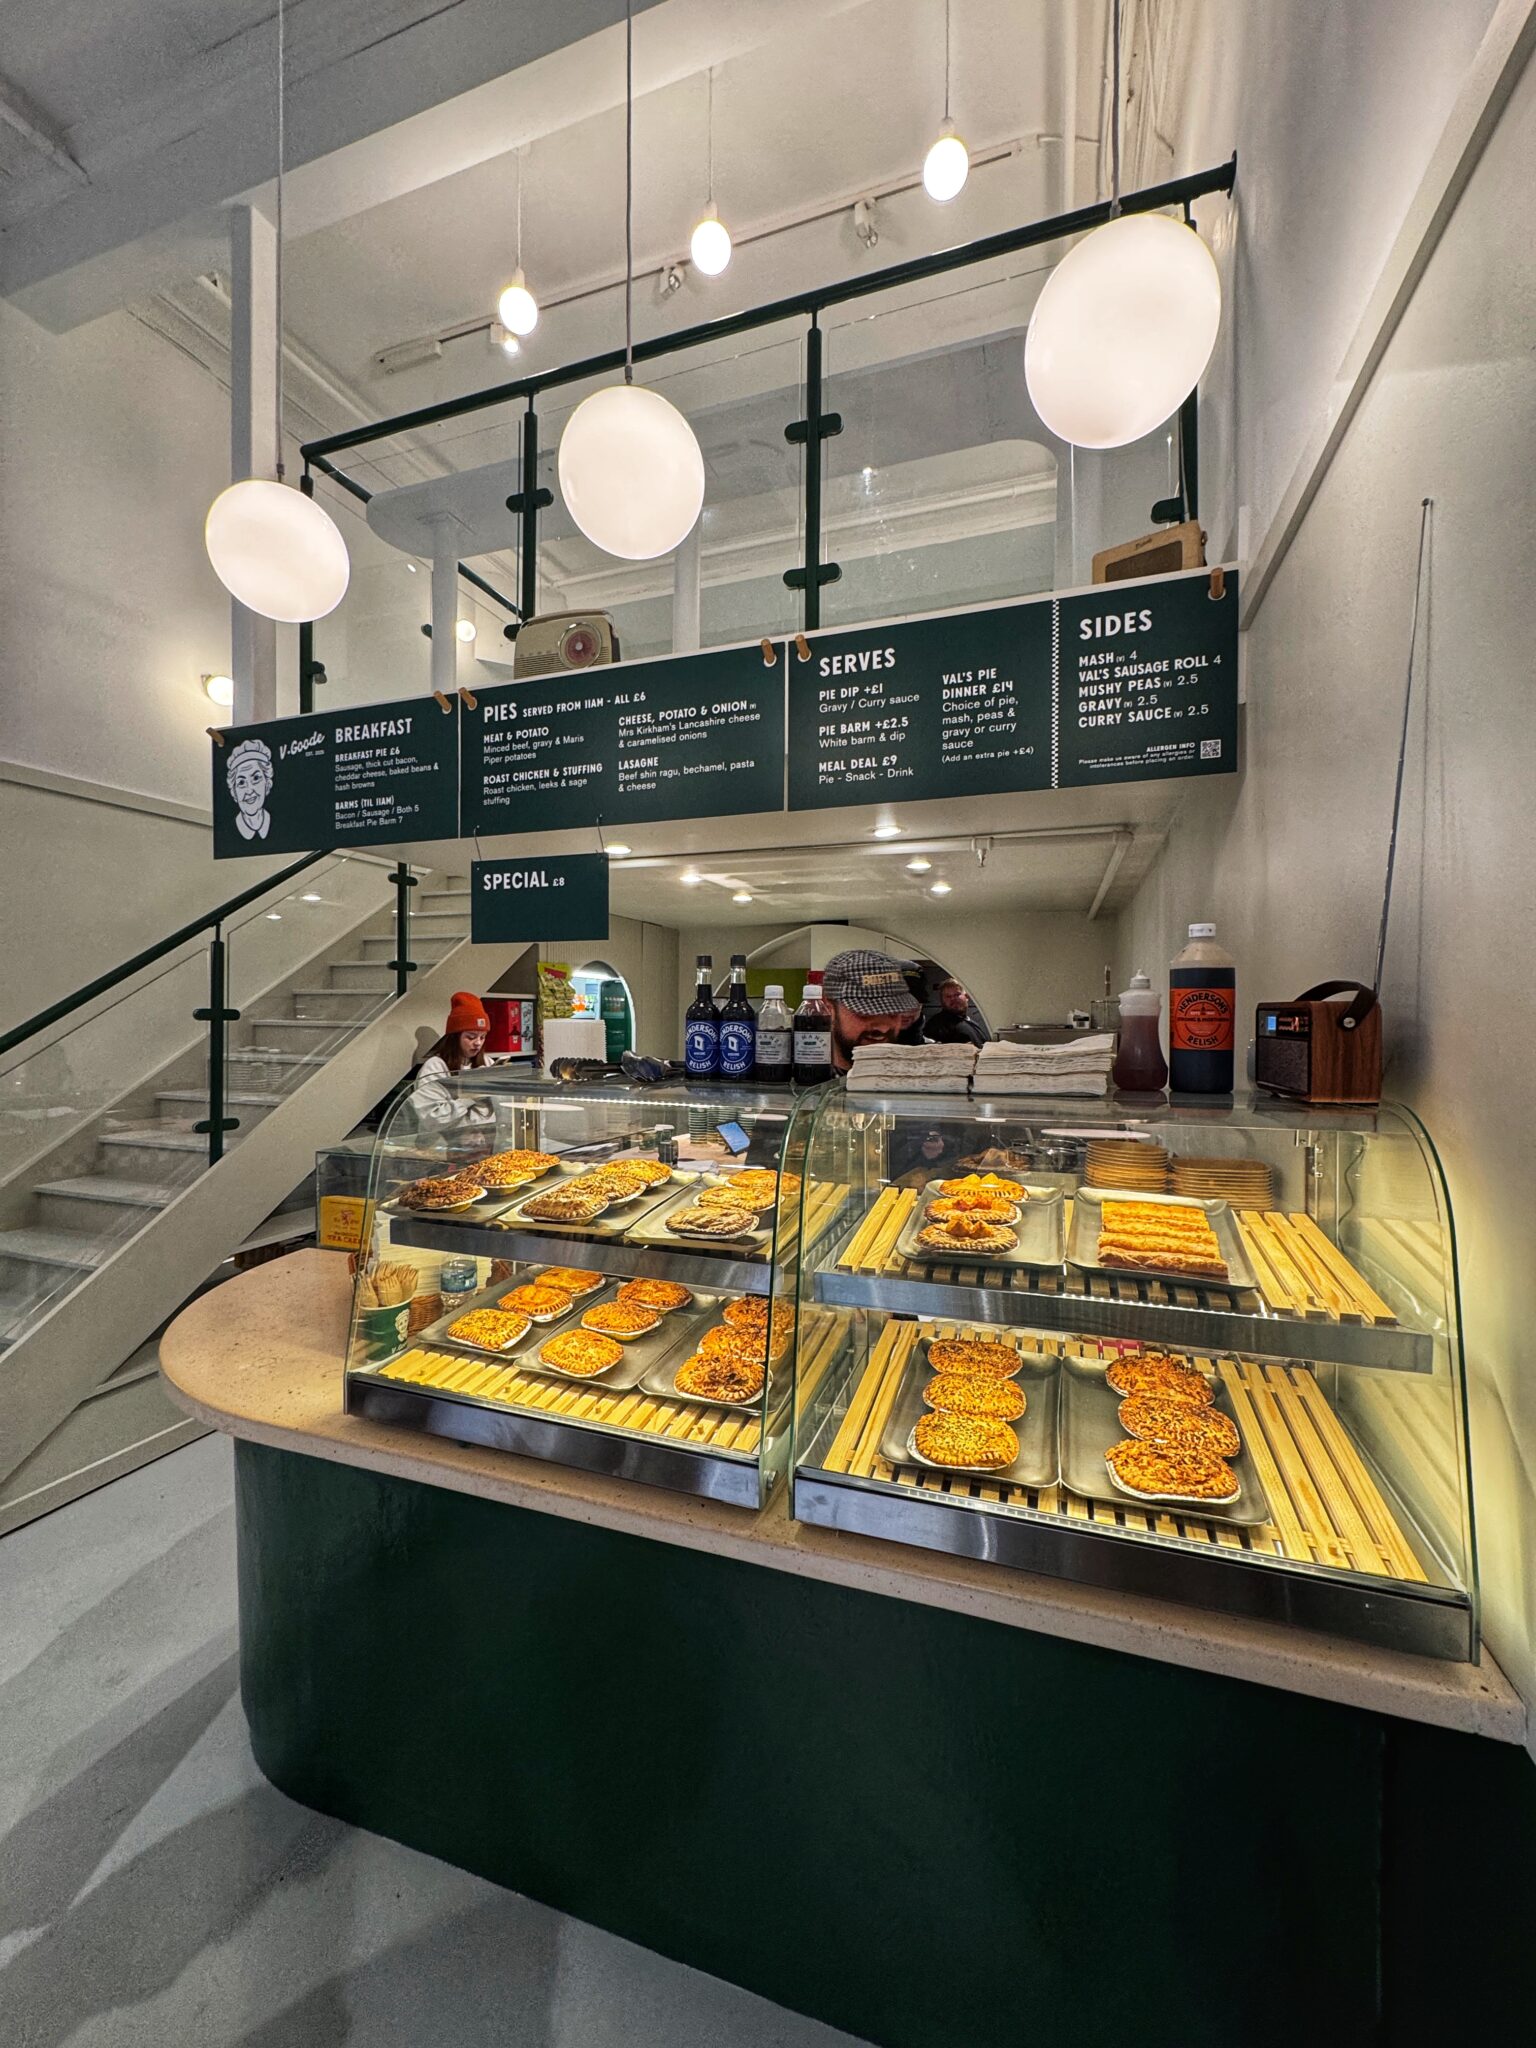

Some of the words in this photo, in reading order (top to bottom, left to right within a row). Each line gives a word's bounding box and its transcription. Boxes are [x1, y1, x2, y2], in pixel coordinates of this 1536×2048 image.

[1079, 609, 1152, 640] SIDES
[819, 648, 896, 677] SERVES
[1079, 651, 1114, 667] MASH
[1129, 650, 1138, 660] 4
[942, 671, 973, 685] VAL'S
[978, 668, 997, 680] PIE
[1079, 668, 1110, 683] VAL'S
[1114, 660, 1170, 678] SAUSAGE
[1174, 655, 1209, 670] ROLL
[1213, 655, 1222, 664] 4
[819, 689, 836, 701] PIE
[840, 686, 860, 698] DIP
[864, 683, 883, 695] +£1
[942, 684, 987, 700] DINNER
[992, 680, 1013, 694] £14
[1079, 681, 1122, 698] MUSHY
[1128, 677, 1161, 692] PEAS
[1177, 674, 1199, 686] 2.5
[484, 702, 517, 723] PIES
[522, 705, 553, 718] SERVED
[556, 701, 581, 713] FROM
[614, 694, 630, 705] ALL
[633, 691, 646, 703] £6
[819, 703, 848, 713] Gravy
[858, 698, 886, 709] Curry
[890, 694, 920, 705] sauce
[942, 700, 980, 713] Choice
[984, 696, 996, 708] of
[998, 695, 1019, 708] pie,
[1078, 697, 1122, 713] GRAVY
[1137, 694, 1158, 706] 2.5
[619, 713, 655, 726] CHEESE,
[659, 707, 697, 721] POTATO
[700, 705, 708, 716] &
[712, 700, 747, 714] ONION
[942, 713, 973, 725] mash,
[977, 711, 1004, 723] peas
[1007, 707, 1016, 717] &
[1078, 712, 1122, 728] CURRY
[1128, 707, 1171, 723] SAUCE
[1188, 704, 1209, 716] 2.5
[335, 718, 413, 744] BREAKFAST
[618, 728, 634, 738] Mrs
[636, 722, 676, 735] Kirkham's
[679, 717, 725, 730] Lancashire
[728, 712, 761, 724] cheese
[819, 724, 836, 737] PIE
[840, 721, 871, 735] BARM
[875, 716, 909, 729] +£2.5
[942, 727, 971, 740] gravy
[974, 726, 985, 734] or
[989, 722, 1017, 732] curry
[483, 732, 504, 744] MEAT
[506, 731, 513, 740] &
[516, 727, 549, 740] POTATO
[483, 743, 510, 754] Minced
[512, 741, 530, 750] beef,
[532, 739, 553, 750] gravy
[555, 736, 561, 745] &
[563, 734, 584, 744] Maris
[618, 739, 624, 749] &
[626, 733, 677, 747] caramelised
[679, 731, 708, 741] onions
[819, 738, 848, 749] White
[851, 735, 876, 746] barm
[879, 732, 886, 742] &
[890, 730, 906, 742] dip
[942, 740, 974, 750] sauce
[1146, 744, 1177, 753] ALLERGEN
[335, 749, 373, 763] BREAKFAST
[375, 748, 387, 758] PIE
[390, 746, 400, 756] £6
[483, 756, 502, 765] Piper
[504, 752, 537, 763] potatoes
[618, 757, 659, 770] LASAGNE
[819, 760, 846, 773] MEAL
[850, 757, 878, 770] DEAL
[882, 754, 897, 766] £9
[941, 753, 961, 764] (Add
[997, 749, 1010, 758] pie
[1012, 746, 1034, 755] +£4)
[335, 763, 364, 772] Sausage,
[365, 760, 381, 769] thick
[382, 759, 393, 767] cut
[395, 756, 418, 765] bacon,
[335, 772, 360, 782] cheddar
[362, 770, 387, 779] cheese,
[389, 767, 409, 776] baked
[411, 764, 431, 773] beans
[433, 762, 439, 770] &
[618, 772, 638, 782] Beef
[640, 770, 657, 779] shin
[659, 768, 681, 779] ragu,
[683, 761, 727, 775] bechamel,
[730, 760, 755, 772] pasta
[483, 773, 510, 785] ROAST
[512, 769, 550, 782] CHICKEN
[553, 768, 560, 777] &
[563, 763, 603, 776] STUFFING
[819, 774, 834, 785] Pie
[845, 771, 876, 782] Snack
[887, 767, 914, 778] Drink
[335, 783, 350, 791] hash
[351, 781, 375, 790] browns
[483, 786, 504, 795] Roast
[506, 783, 536, 793] chicken,
[538, 780, 558, 790] leeks
[561, 778, 566, 787] &
[568, 778, 588, 788] sage
[618, 783, 624, 792] &
[626, 781, 657, 792] cheese
[335, 800, 359, 810] BARMS
[360, 798, 374, 809] (TIL
[483, 796, 510, 806] stuffing
[335, 812, 356, 820] Bacon
[362, 808, 390, 818] Sausage
[396, 806, 412, 814] Both
[335, 821, 365, 830] Breakfast
[367, 818, 377, 827] Pie
[379, 818, 397, 826] Barm
[398, 816, 403, 824] 7
[483, 870, 549, 891] SPECIAL
[552, 877, 565, 887] £8
[1186, 1035, 1218, 1046] RELISH
[689, 1060, 712, 1069] RELISH
[723, 1061, 746, 1070] RELISH
